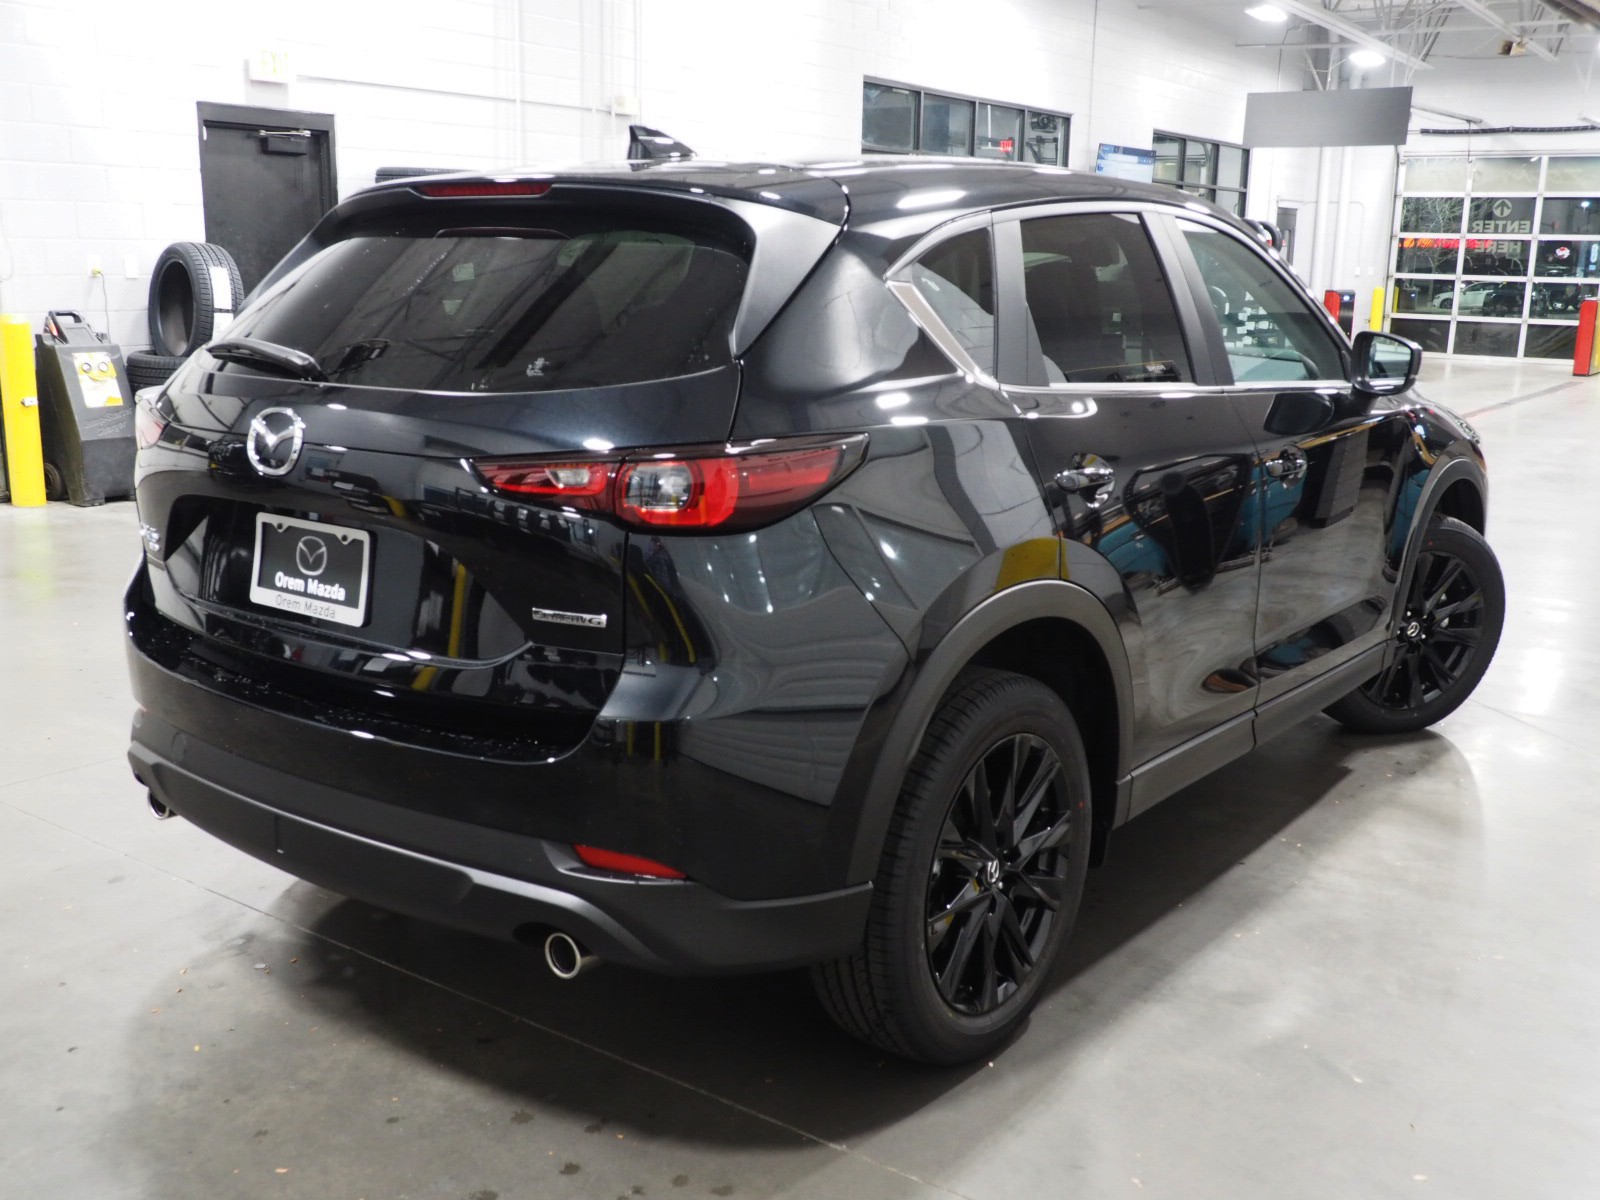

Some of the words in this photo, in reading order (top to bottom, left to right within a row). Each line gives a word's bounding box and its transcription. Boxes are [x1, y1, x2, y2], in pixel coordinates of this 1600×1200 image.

[274, 571, 305, 592] Orem
[307, 578, 346, 601] Mazda
[275, 594, 301, 610] Orem
[303, 602, 336, 619] Mazda
